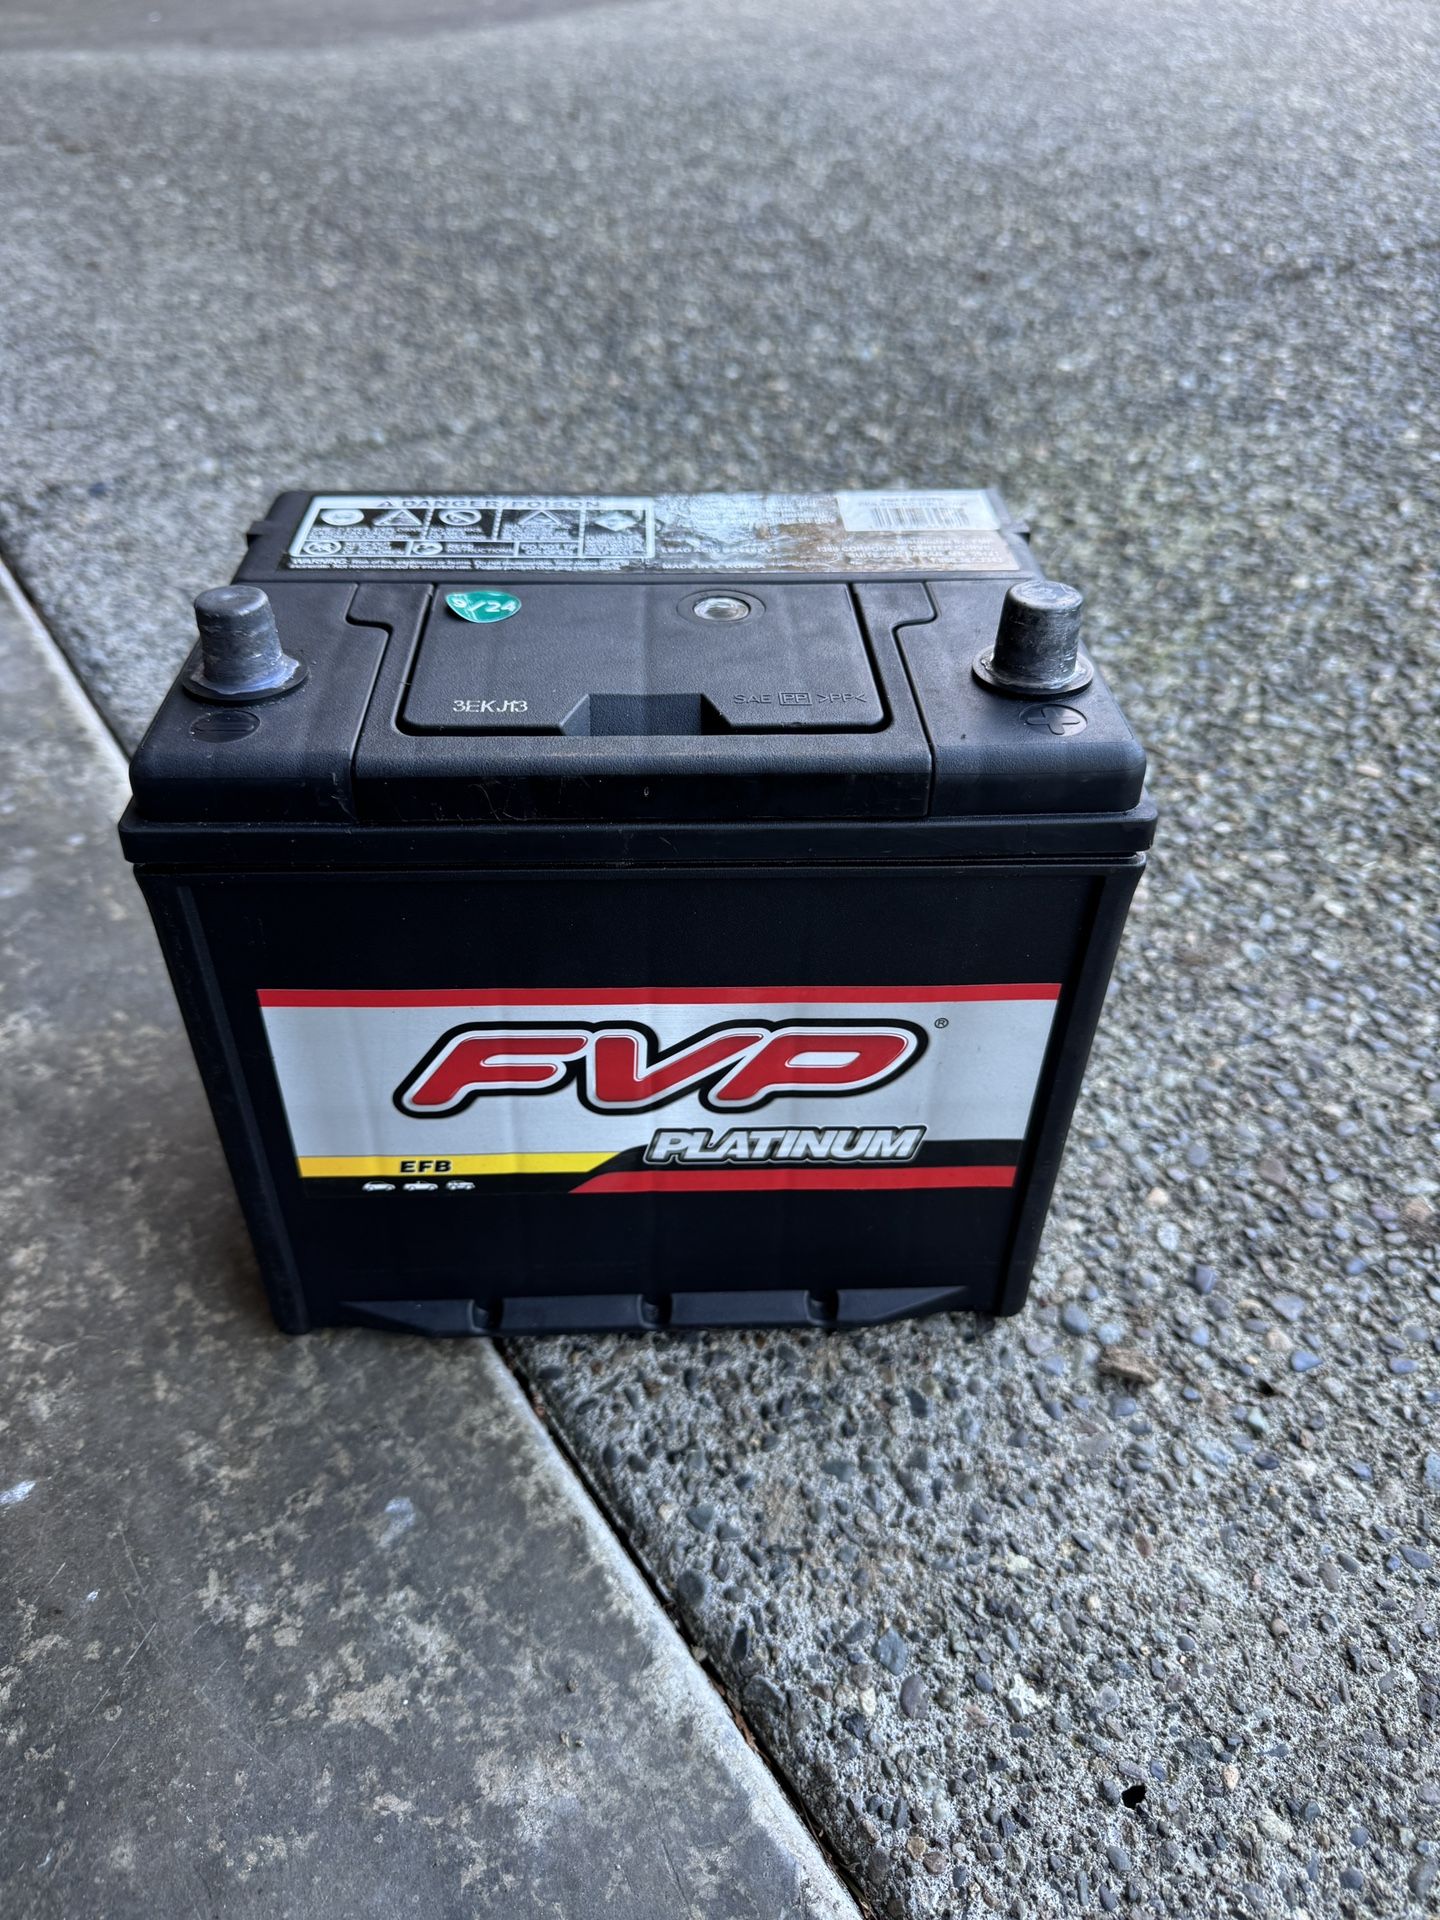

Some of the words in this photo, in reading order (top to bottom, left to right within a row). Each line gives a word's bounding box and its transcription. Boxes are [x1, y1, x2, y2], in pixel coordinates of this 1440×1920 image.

[733, 693, 773, 705] SAE
[780, 692, 810, 705] PP
[395, 1021, 926, 1116] FVP
[648, 1127, 922, 1161] PLATINUM
[400, 1160, 452, 1173] EFB
